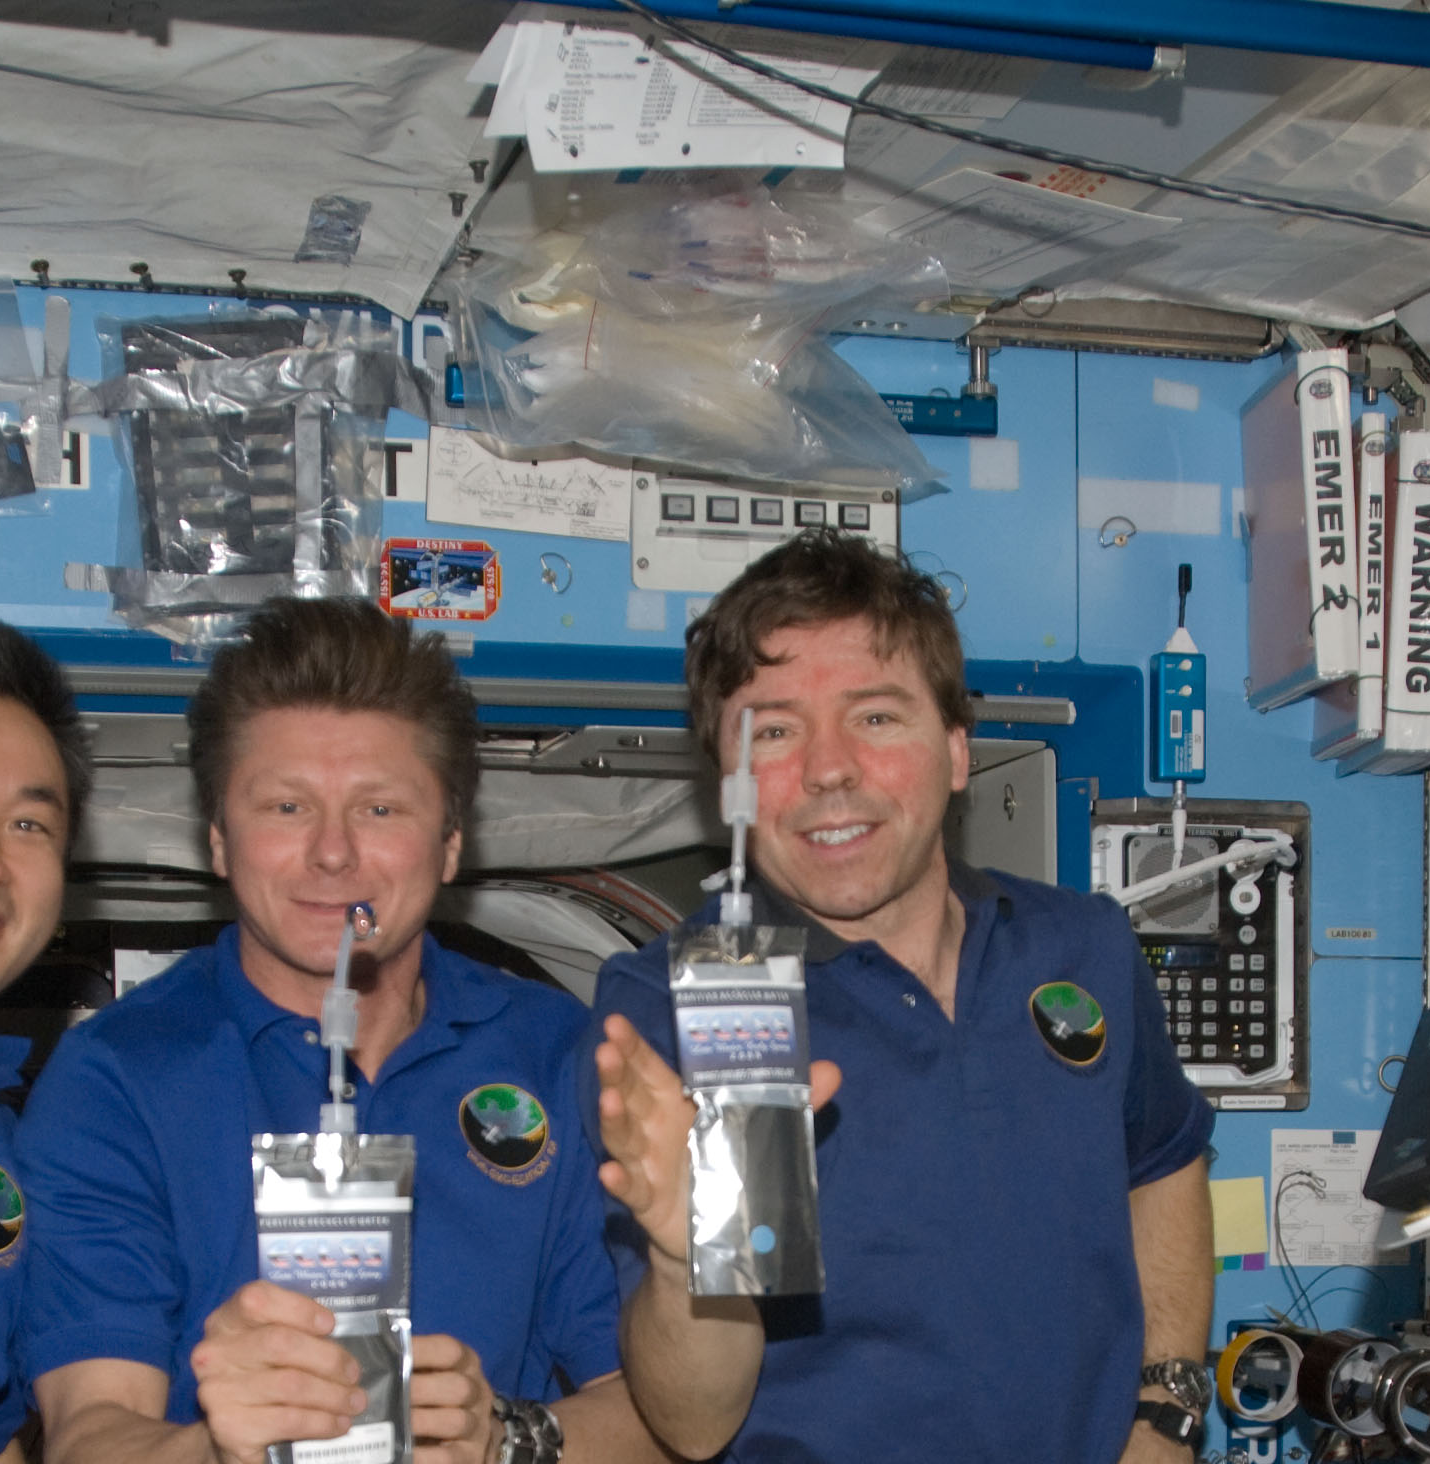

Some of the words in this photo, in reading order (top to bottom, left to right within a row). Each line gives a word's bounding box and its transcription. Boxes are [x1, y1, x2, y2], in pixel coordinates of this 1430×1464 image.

[1312, 428, 1346, 568] EMER
[415, 538, 464, 551] DESTINY
[1366, 494, 1383, 617] EMER
[1321, 583, 1349, 612] 2
[437, 608, 459, 619] LAB
[1365, 632, 1381, 650] 1
